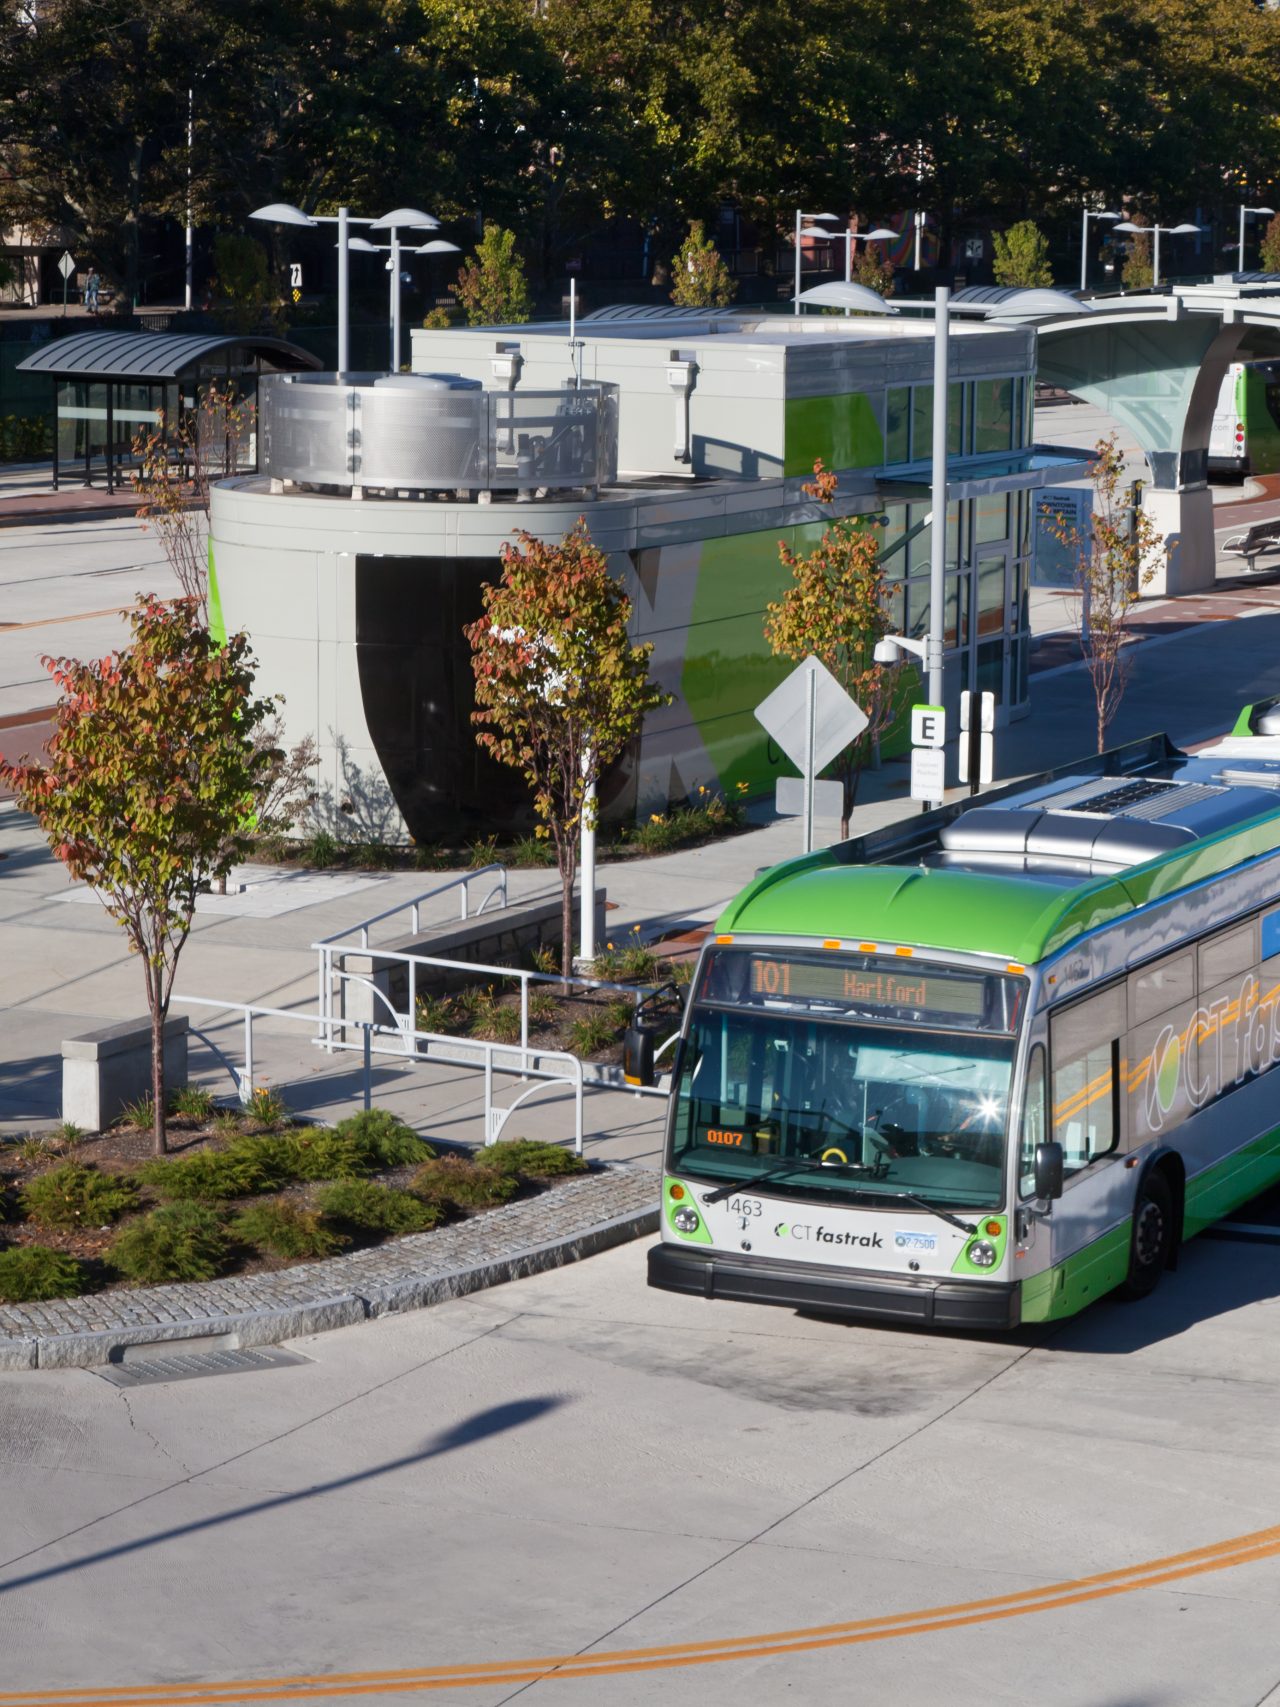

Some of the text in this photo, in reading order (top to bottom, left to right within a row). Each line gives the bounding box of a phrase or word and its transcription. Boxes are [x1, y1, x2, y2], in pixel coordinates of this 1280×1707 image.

[922, 716, 935, 740] E
[753, 959, 927, 1006] 101 Hartford
[707, 1129, 743, 1147] 0107
[725, 1198, 762, 1217] 1463
[791, 1223, 883, 1249] CT fastrak
